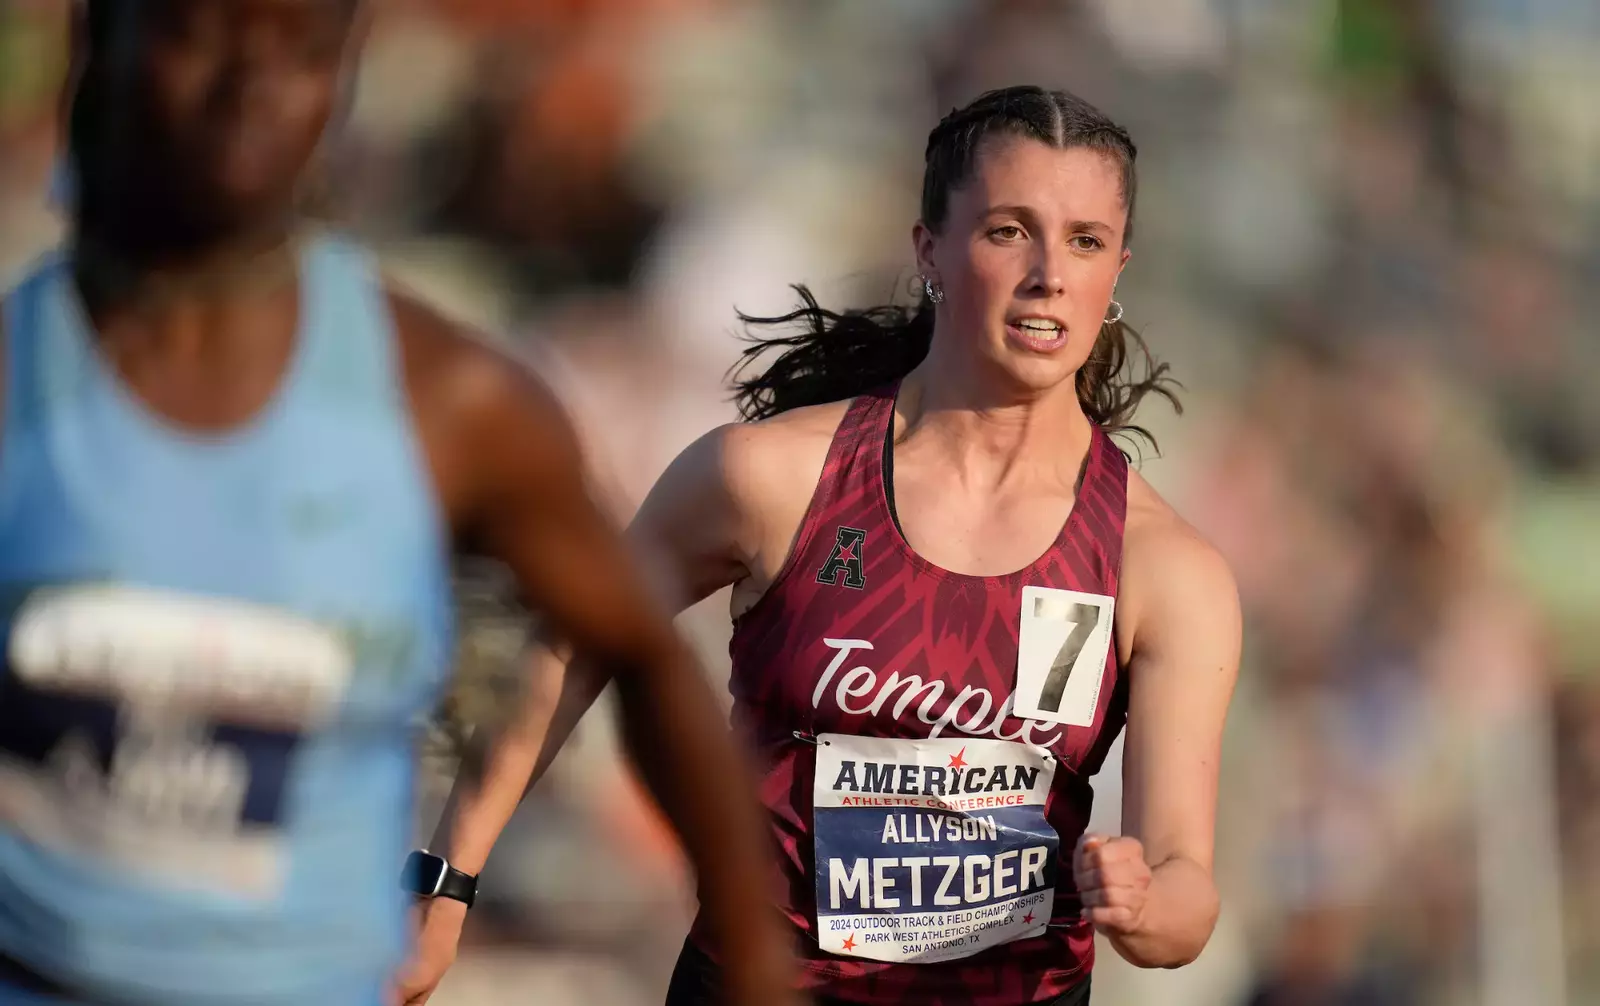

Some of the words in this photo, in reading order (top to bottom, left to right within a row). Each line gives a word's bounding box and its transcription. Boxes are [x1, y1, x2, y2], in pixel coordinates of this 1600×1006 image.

[1033, 597, 1101, 713] 7
[812, 638, 1063, 746] Temple
[832, 760, 1041, 796] AMERICAN
[842, 796, 920, 807] ATHLETIC
[926, 794, 1025, 811] CONFERENCE
[881, 814, 998, 844] ALLYSON
[829, 845, 1049, 910] METZGER
[830, 918, 851, 931] 2024
[853, 916, 901, 930] OUTDOOR
[903, 915, 936, 929] TRACK
[938, 915, 945, 926] &
[946, 911, 973, 925] FIELD
[974, 893, 1046, 920] CHAMPIONSHIPS
[864, 931, 891, 944] PARK
[892, 930, 919, 942] WEST
[921, 924, 971, 941] ATHLETICS
[973, 914, 1015, 933] COMPLEX
[902, 943, 922, 954] SAN
[924, 937, 967, 952] ANTONIO,
[970, 934, 980, 944] TX
